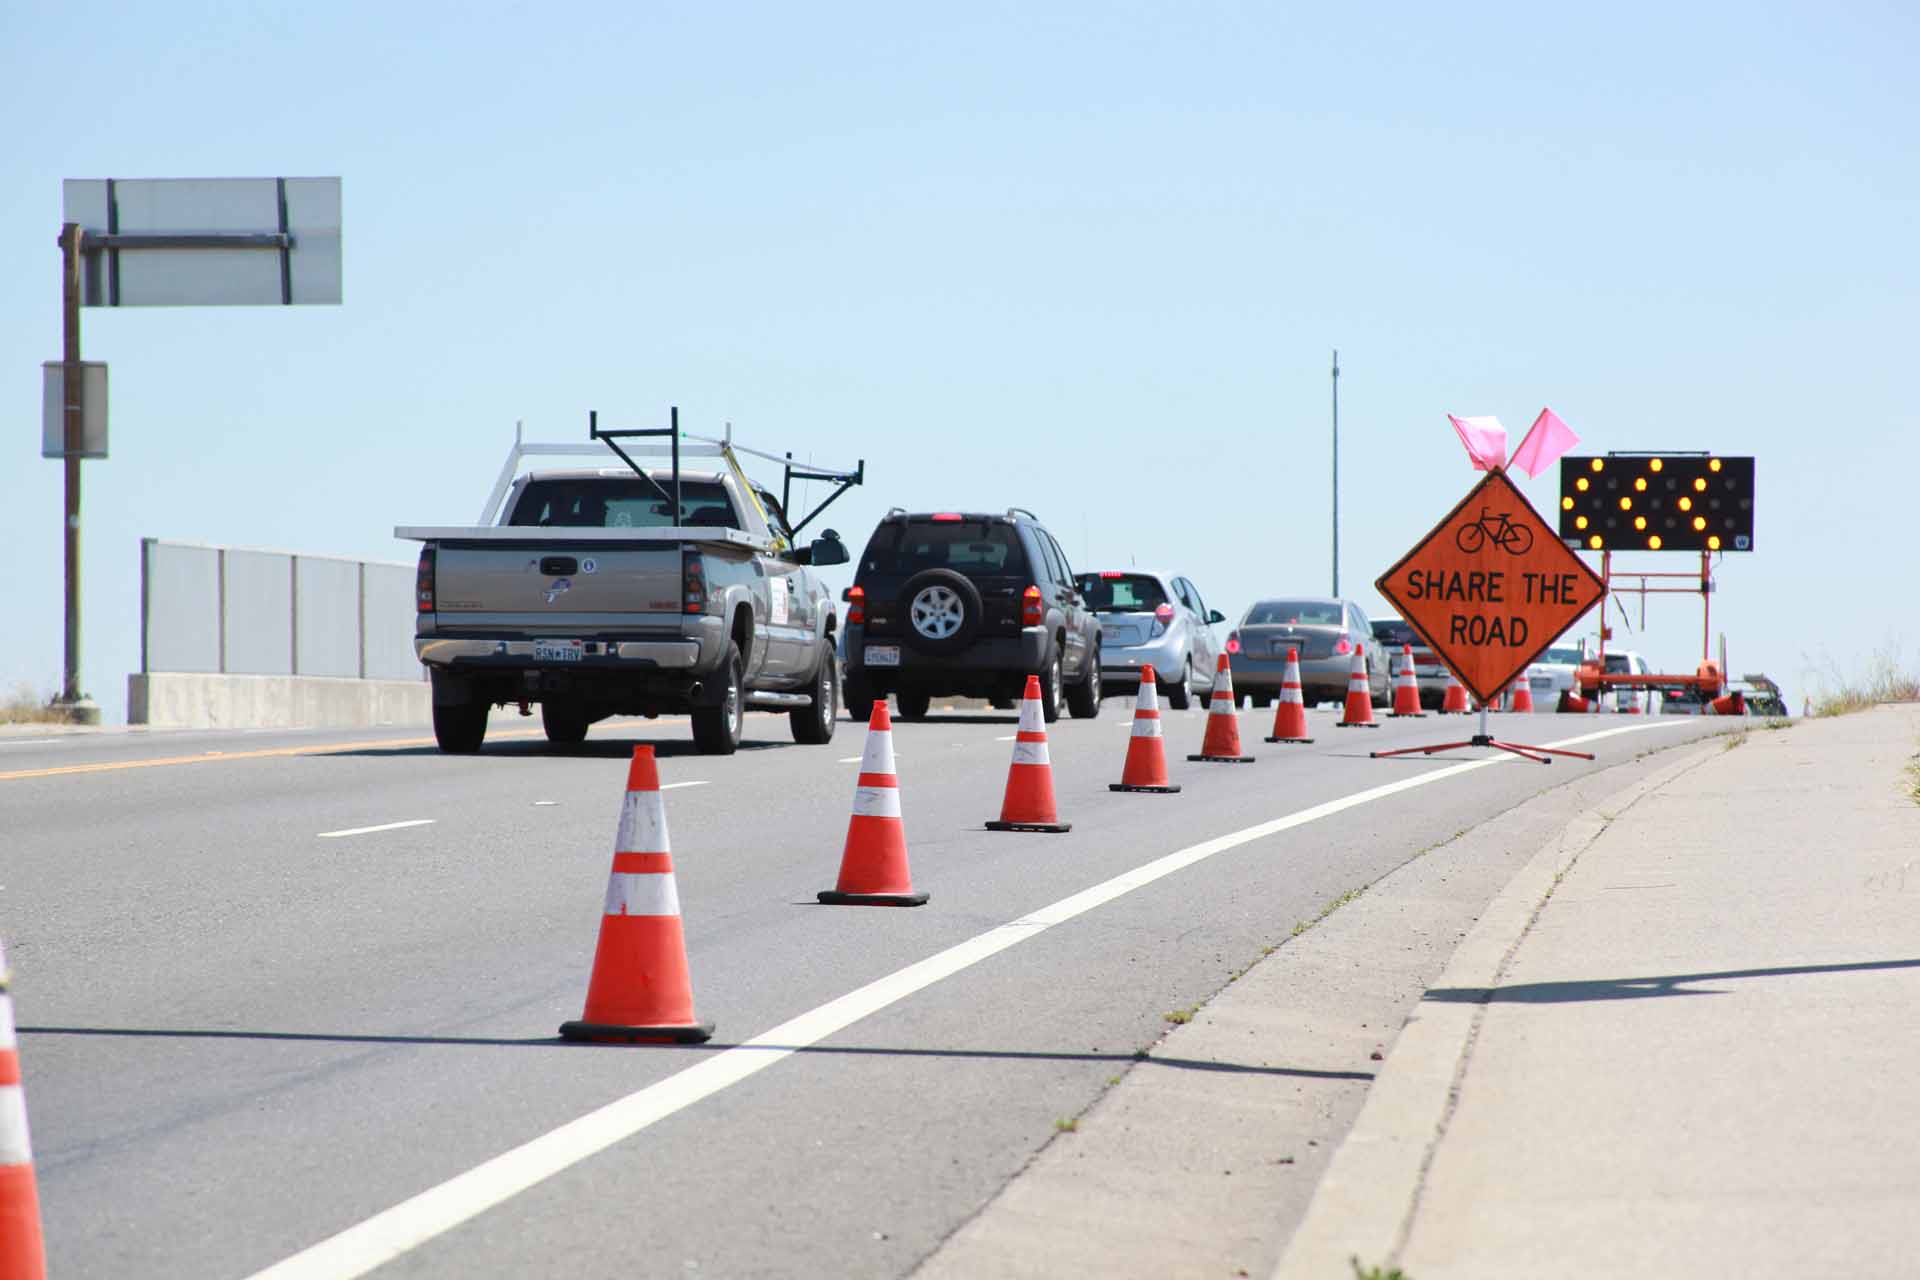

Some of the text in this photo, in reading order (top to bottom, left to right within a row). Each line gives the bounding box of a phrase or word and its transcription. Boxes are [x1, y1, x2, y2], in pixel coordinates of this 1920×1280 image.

[1407, 569, 1578, 605] SHARE THE
[1450, 614, 1528, 647] ROAD
